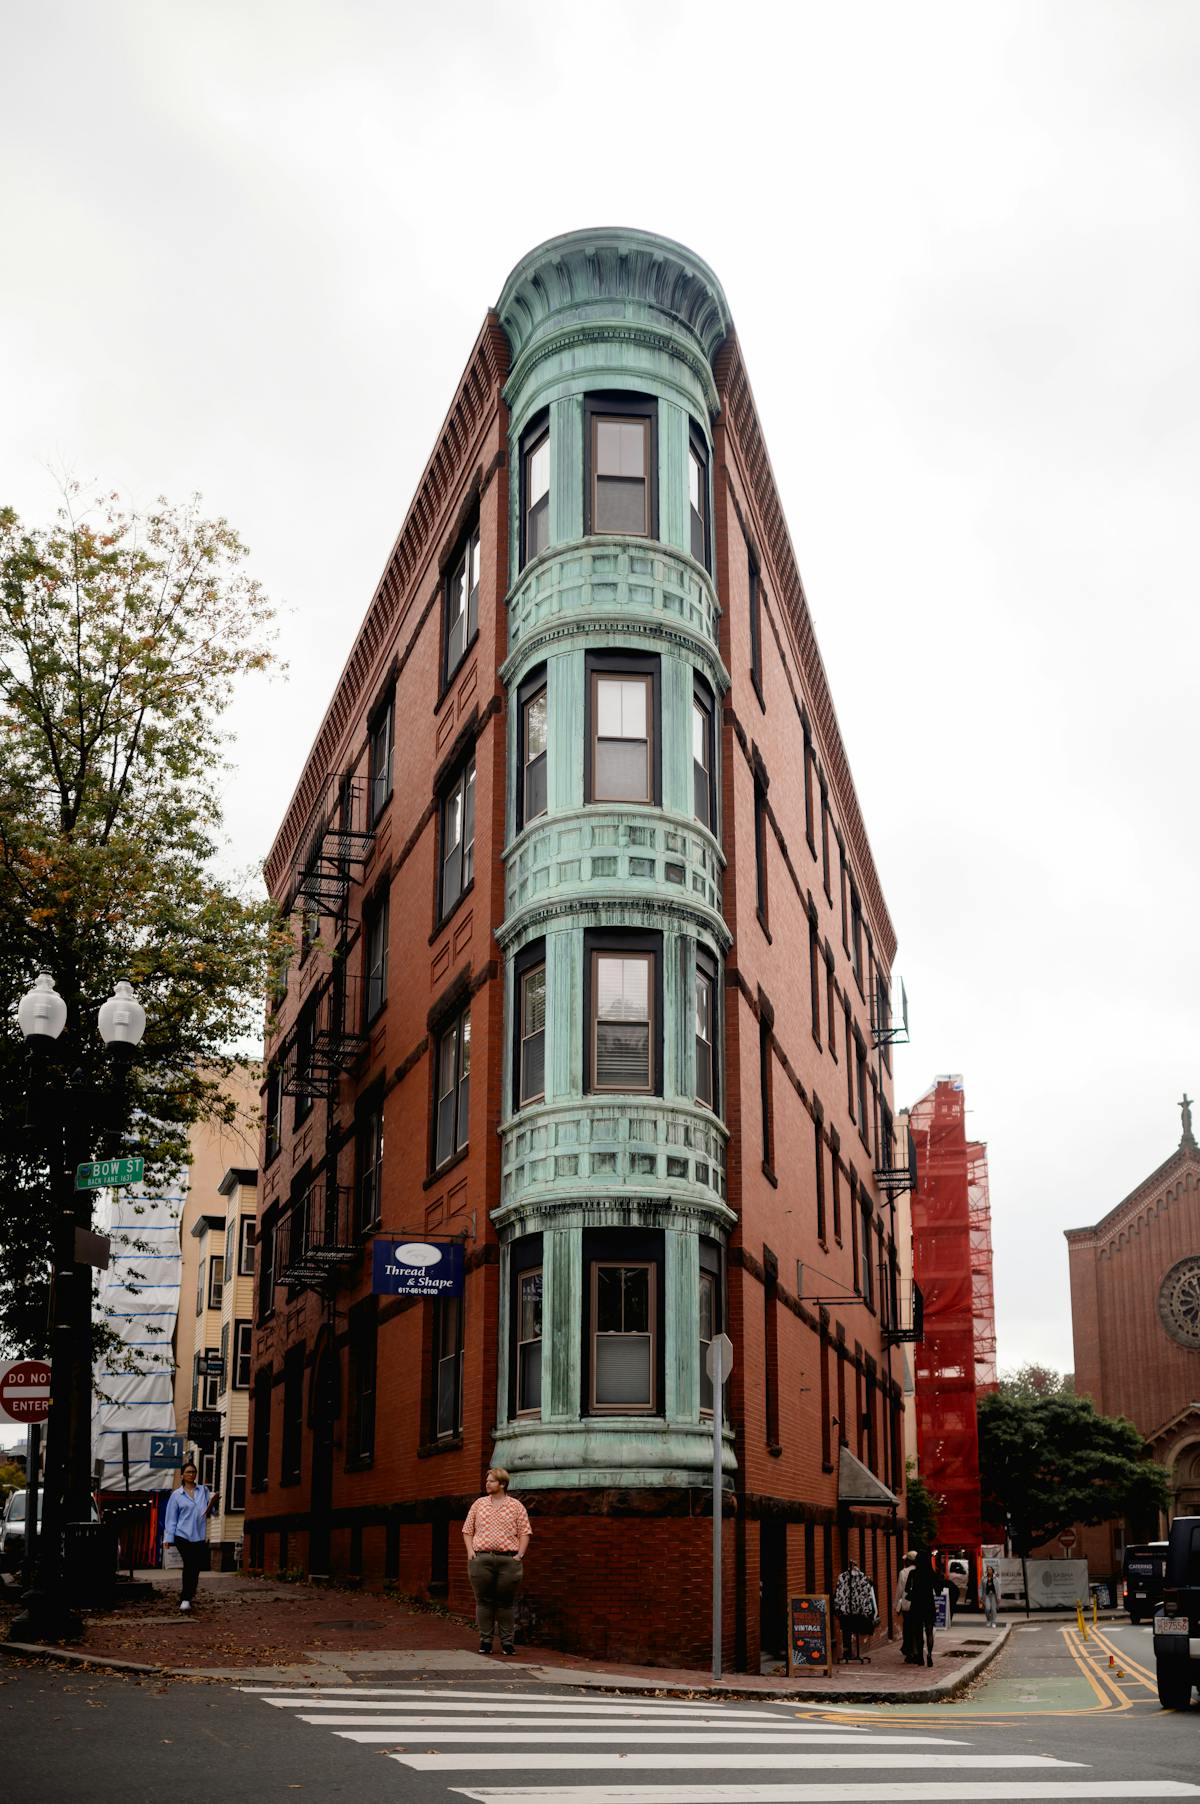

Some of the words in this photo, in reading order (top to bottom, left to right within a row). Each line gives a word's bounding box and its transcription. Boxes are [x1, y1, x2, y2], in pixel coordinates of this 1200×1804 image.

[93, 1162, 120, 1177] BOW
[126, 1159, 142, 1173] ST
[384, 1264, 426, 1277] Thread
[406, 1278, 415, 1286] &
[417, 1276, 454, 1289] Shape
[8, 1373, 25, 1384] DO
[12, 1401, 49, 1411] ENTER
[793, 1624, 822, 1632] VINTAGE
